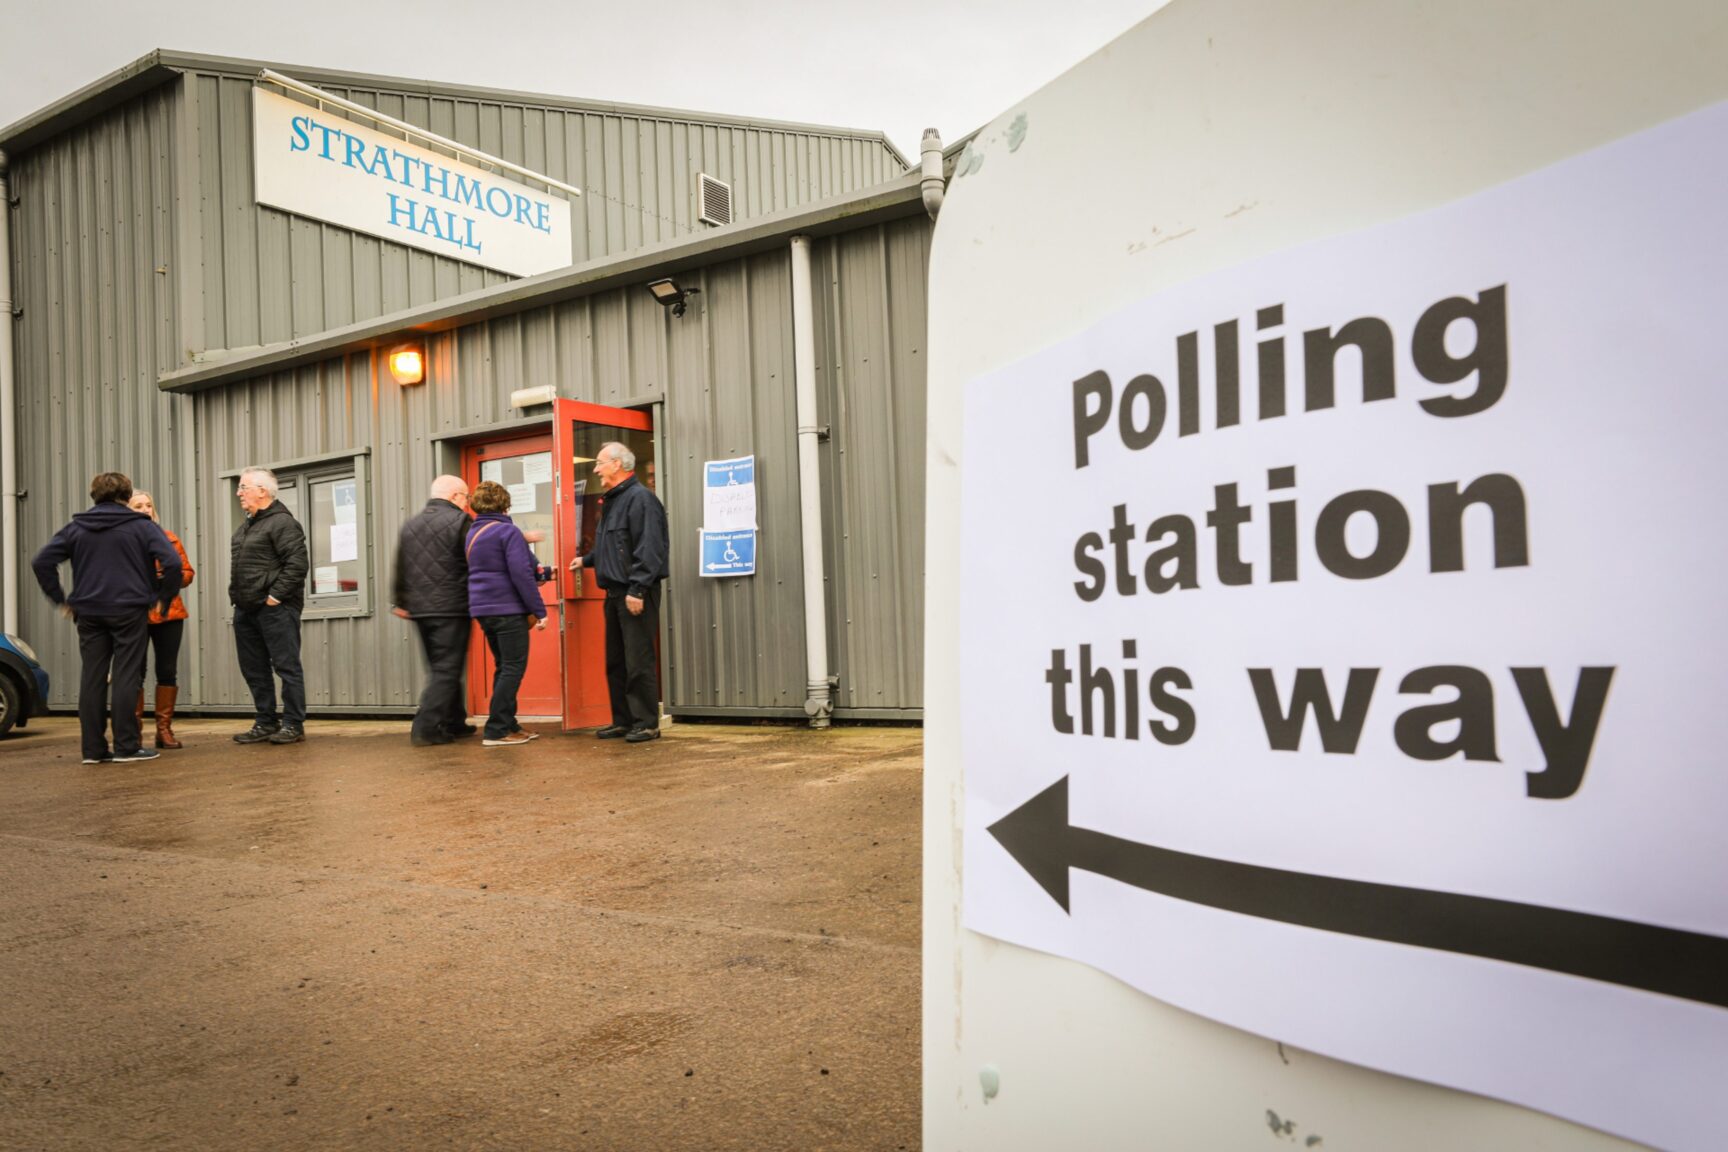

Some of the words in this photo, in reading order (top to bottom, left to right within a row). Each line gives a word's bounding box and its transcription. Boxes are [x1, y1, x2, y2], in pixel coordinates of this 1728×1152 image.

[290, 115, 551, 234] STRATHMORE
[386, 192, 482, 255] HALL
[1072, 282, 1509, 470] Polling
[1073, 464, 1530, 602] station
[1046, 638, 1196, 745] this
[1246, 665, 1616, 800] way
